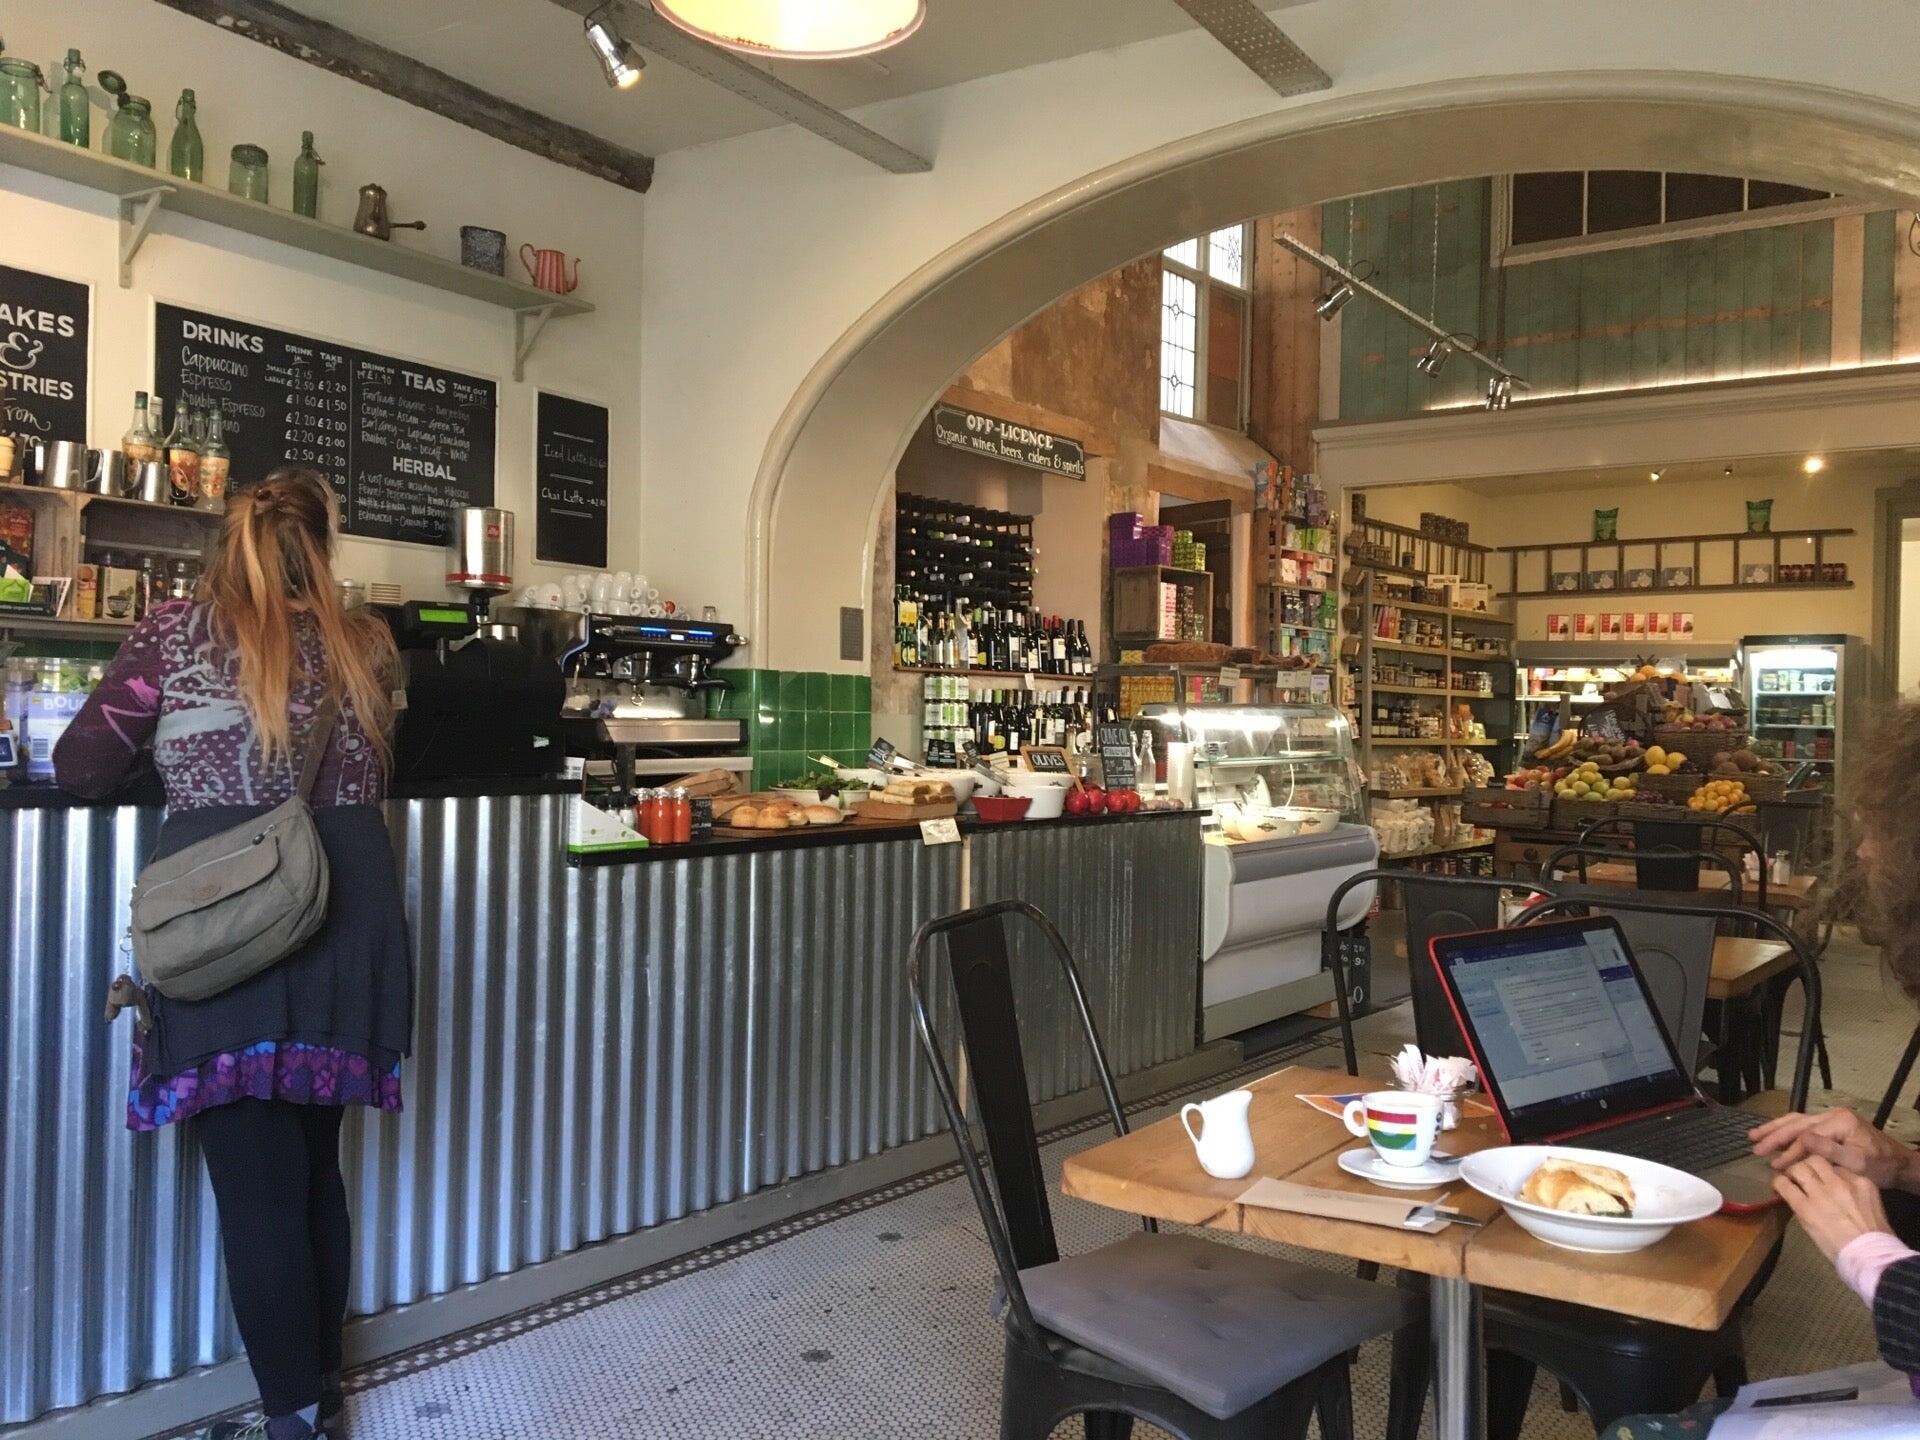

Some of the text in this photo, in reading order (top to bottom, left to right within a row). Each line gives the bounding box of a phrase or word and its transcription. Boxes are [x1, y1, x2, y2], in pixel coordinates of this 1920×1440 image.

[182, 319, 264, 353] DRINKS
[181, 345, 249, 378] Cappuccino
[285, 343, 343, 364] DRINK TAKE
[401, 370, 447, 394] TEAS
[452, 382, 472, 393] TAKE
[966, 413, 1054, 449] OFF-LICENCE
[935, 423, 967, 445] Organic
[971, 436, 998, 454] wines,
[1001, 440, 1024, 460] beers,
[1027, 448, 1051, 467] ciders
[1062, 459, 1085, 475] spirits
[392, 456, 457, 482] HERBAL
[1031, 753, 1066, 766] OLIVES
